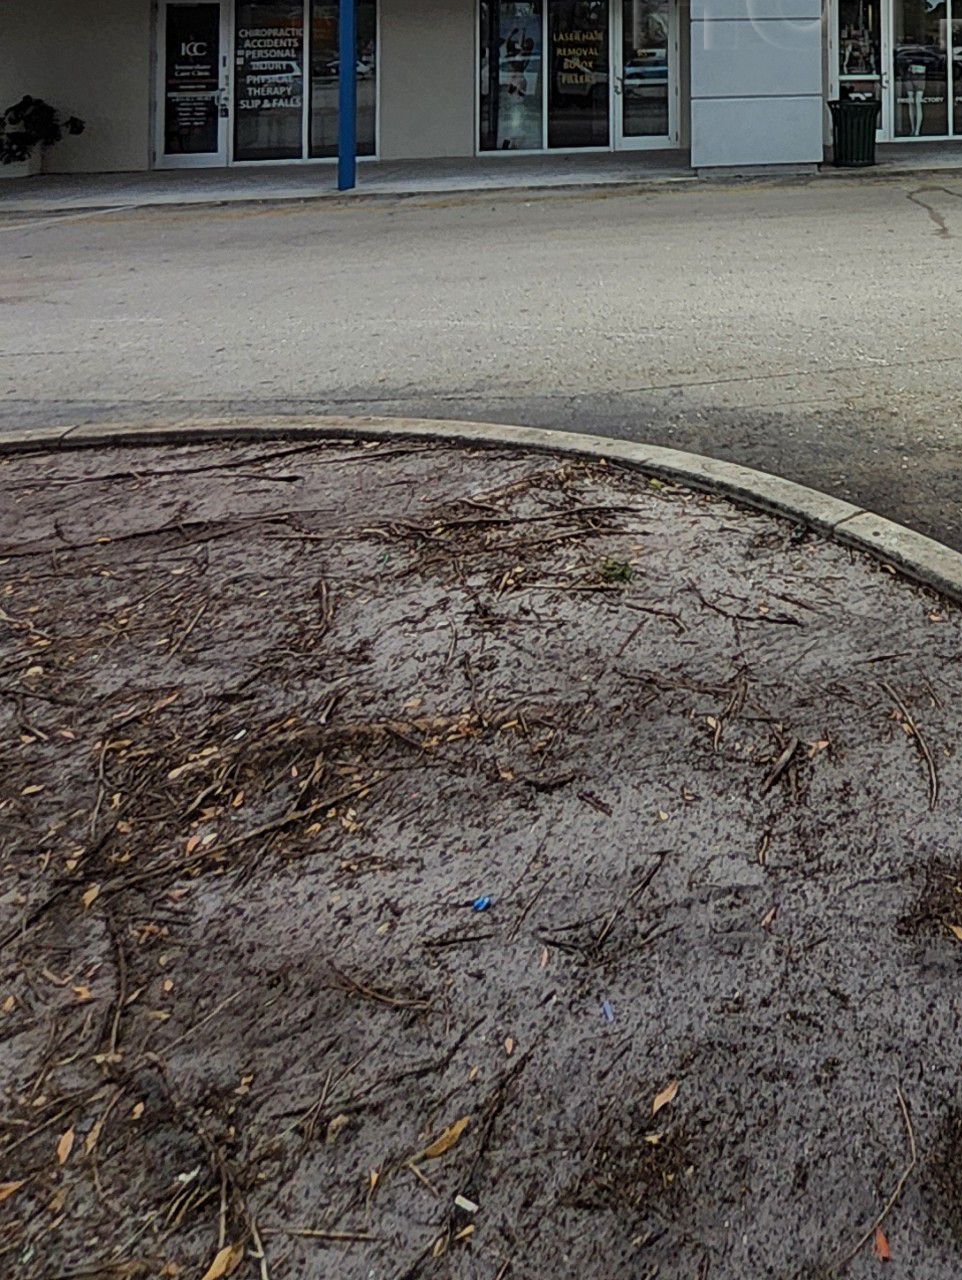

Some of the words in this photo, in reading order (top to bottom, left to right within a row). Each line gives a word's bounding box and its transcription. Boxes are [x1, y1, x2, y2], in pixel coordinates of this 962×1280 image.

[239, 28, 303, 38] CHIROPRACTIC
[244, 39, 299, 48] ACCIDENTS
[245, 49, 296, 59] PERSONAL
[556, 47, 599, 57] REMOVAL
[247, 86, 292, 97] THERAPY
[240, 99, 261, 109] SLIP
[262, 99, 271, 108] &
[272, 98, 302, 108] FALLS
